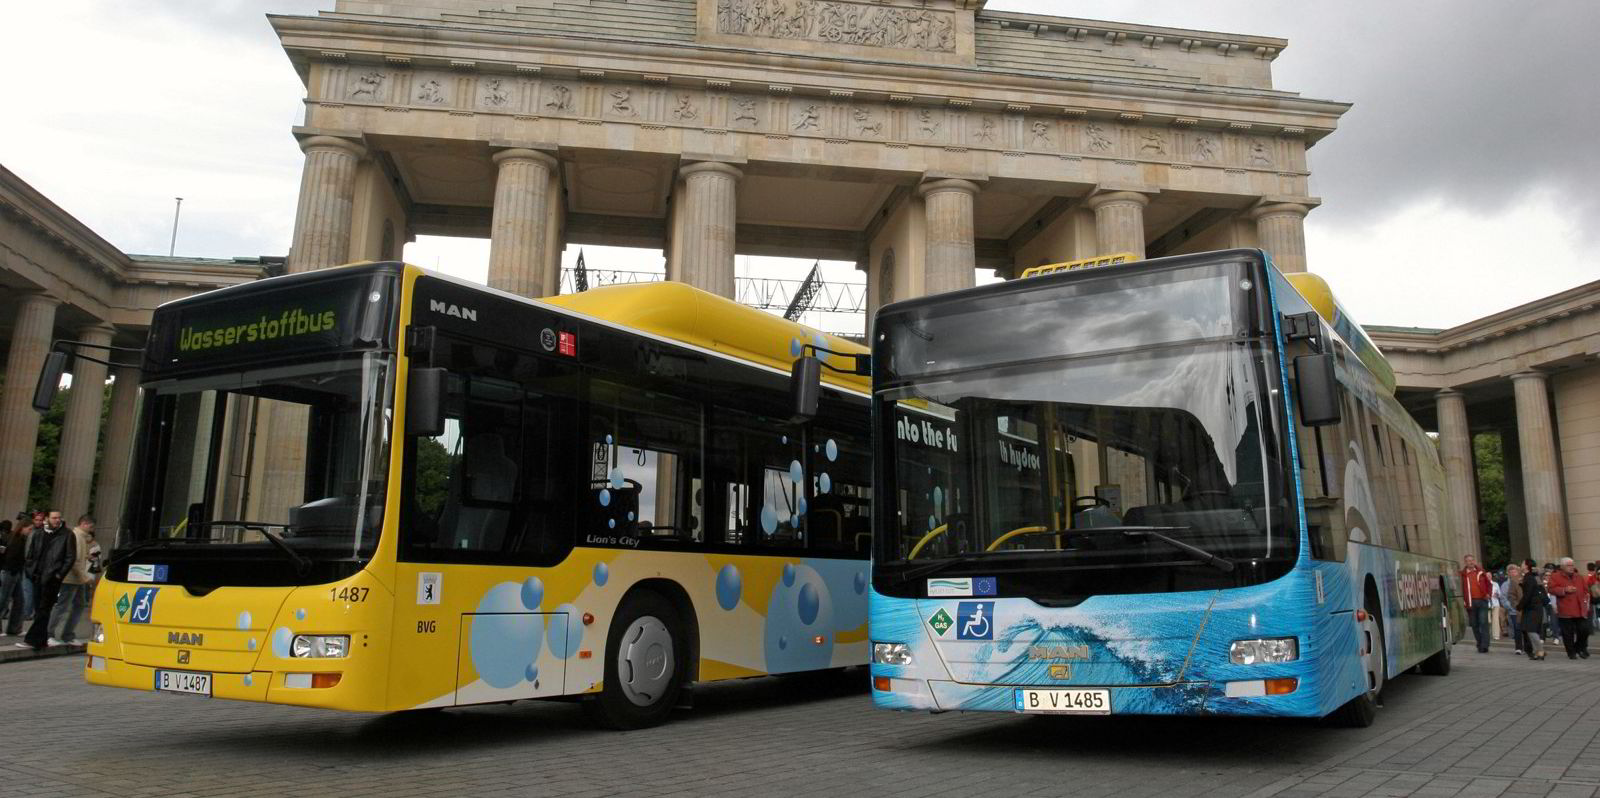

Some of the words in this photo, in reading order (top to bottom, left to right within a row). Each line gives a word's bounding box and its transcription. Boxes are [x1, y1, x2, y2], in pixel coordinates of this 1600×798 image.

[430, 299, 477, 321] MAN
[180, 308, 335, 351] Wasserstoffbus
[921, 420, 943, 449] the
[586, 534, 617, 545] Lion's
[619, 536, 640, 548] City
[330, 587, 370, 602] 1487
[417, 620, 436, 633] BVG
[168, 632, 203, 645] MAN
[1028, 645, 1089, 660] MAN
[163, 673, 170, 687] B
[176, 674, 182, 689] V
[183, 675, 207, 691] 1487
[1029, 692, 1039, 707] B
[1049, 692, 1059, 707] V
[1064, 692, 1103, 708] 1485
